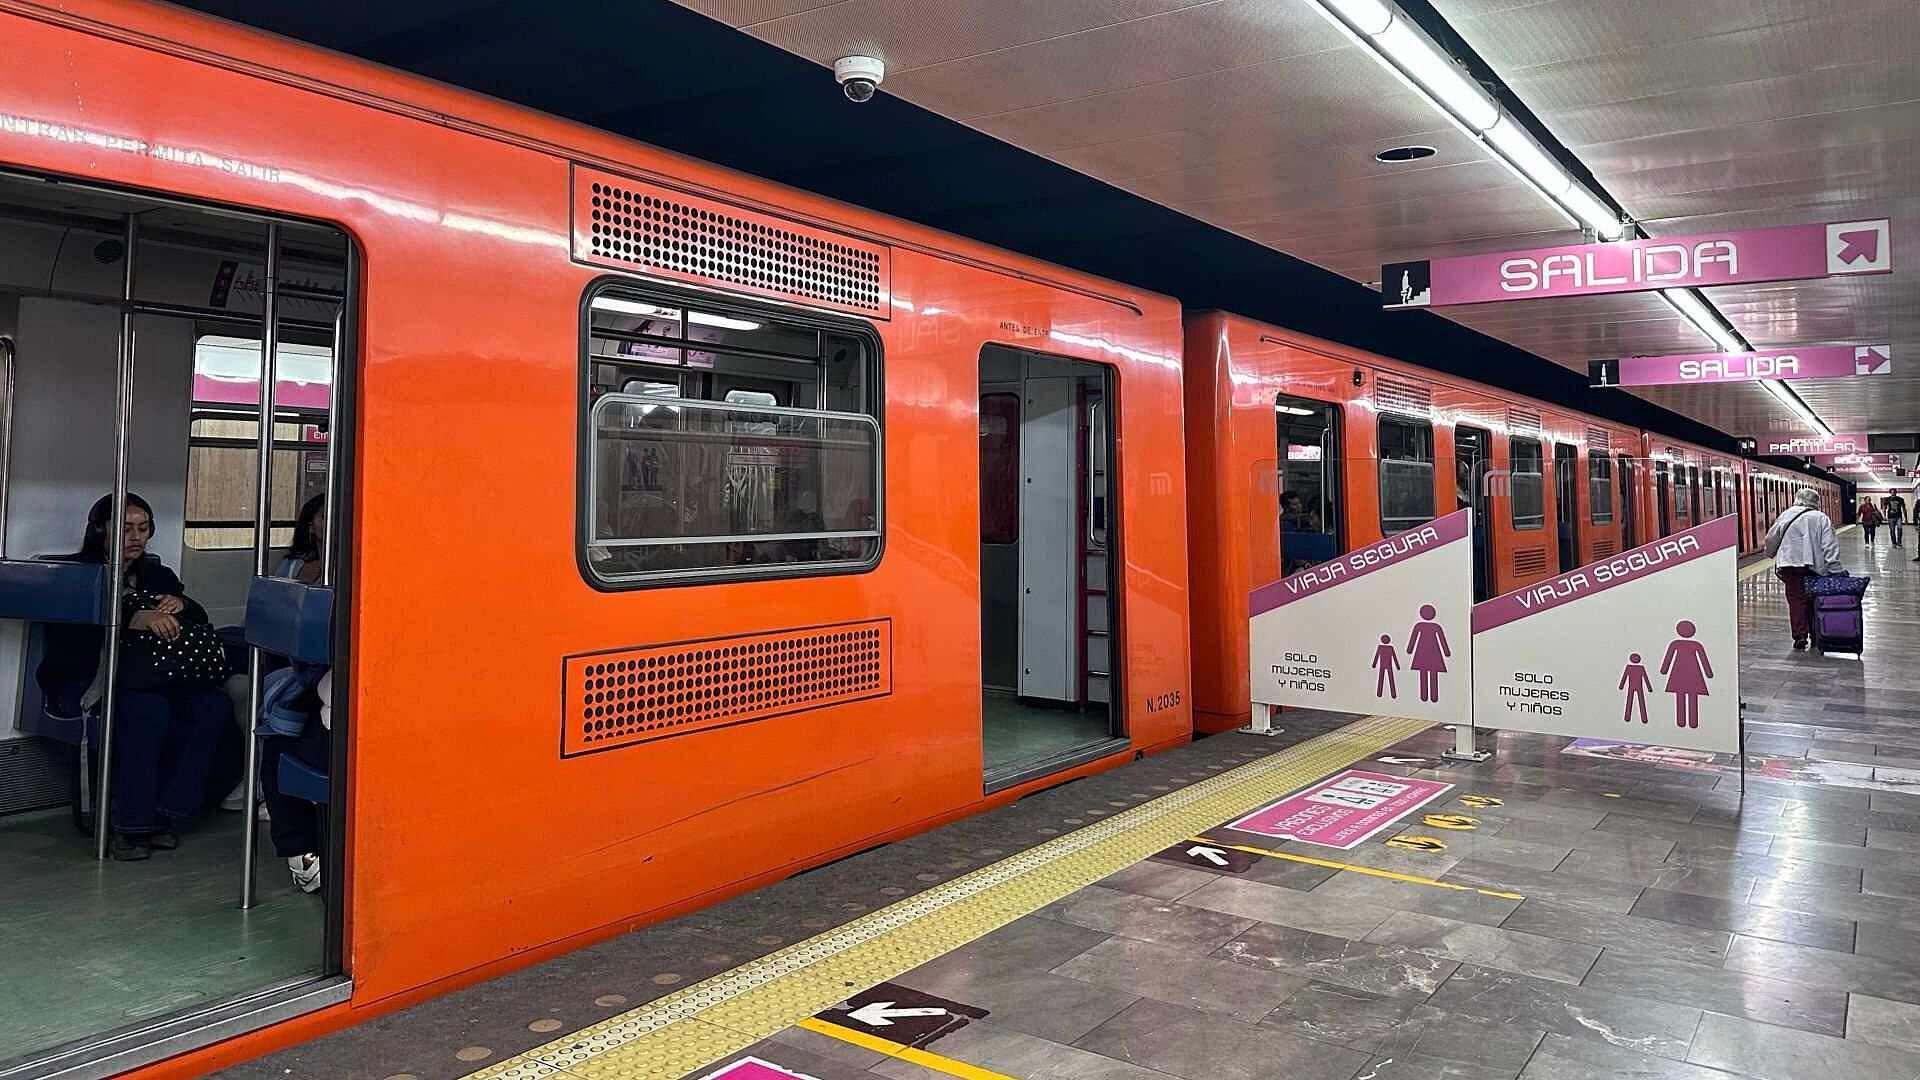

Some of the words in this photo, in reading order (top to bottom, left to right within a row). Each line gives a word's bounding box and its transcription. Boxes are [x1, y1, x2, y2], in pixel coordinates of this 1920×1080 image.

[1500, 240, 1738, 292] SALIDA
[1679, 355, 1799, 379] SALIDA
[1285, 563, 1346, 595] VIAJA
[1350, 527, 1438, 571] SEGURA
[1515, 570, 1590, 609] VIAJA
[1593, 535, 1699, 583] SEGURA
[1284, 652, 1317, 664] SOLO
[1271, 664, 1331, 679] MUJERES
[1514, 672, 1553, 684] SOLO
[1278, 679, 1287, 689] Y
[1289, 678, 1326, 692] NIÑOS
[1147, 690, 1180, 712] N.2035
[1500, 686, 1569, 701] MUJERES
[1506, 702, 1516, 712] Y
[1521, 700, 1562, 715] NIÑOS
